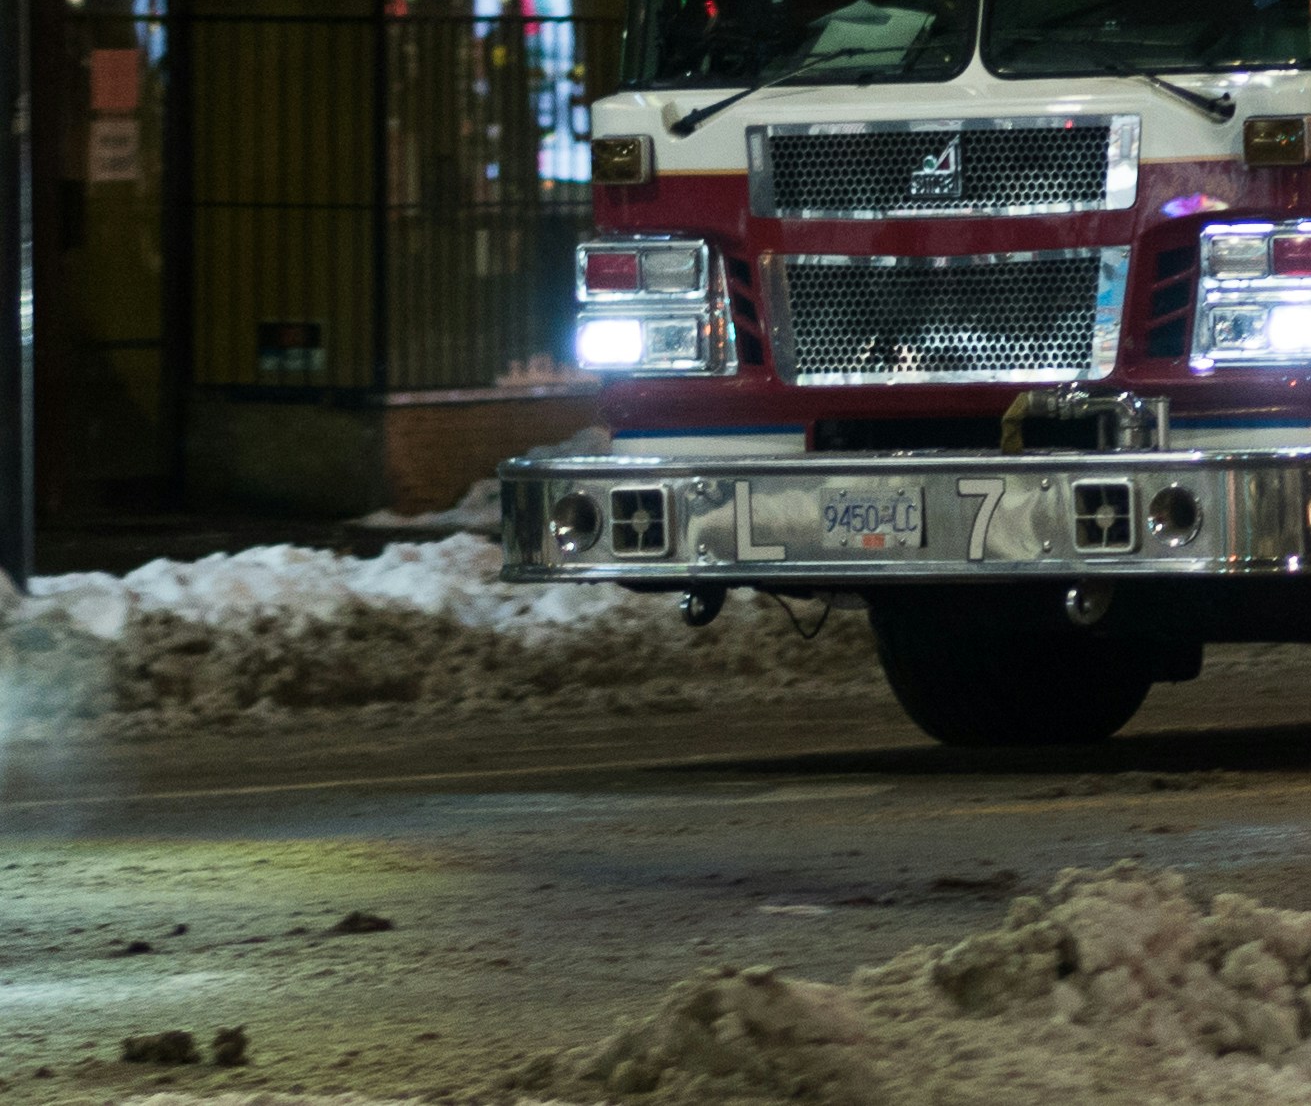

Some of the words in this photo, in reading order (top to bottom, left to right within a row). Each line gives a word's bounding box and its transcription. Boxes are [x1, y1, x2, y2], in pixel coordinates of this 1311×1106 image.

[735, 481, 786, 561] L
[824, 505, 880, 533] 9450
[956, 478, 1006, 562] 7
